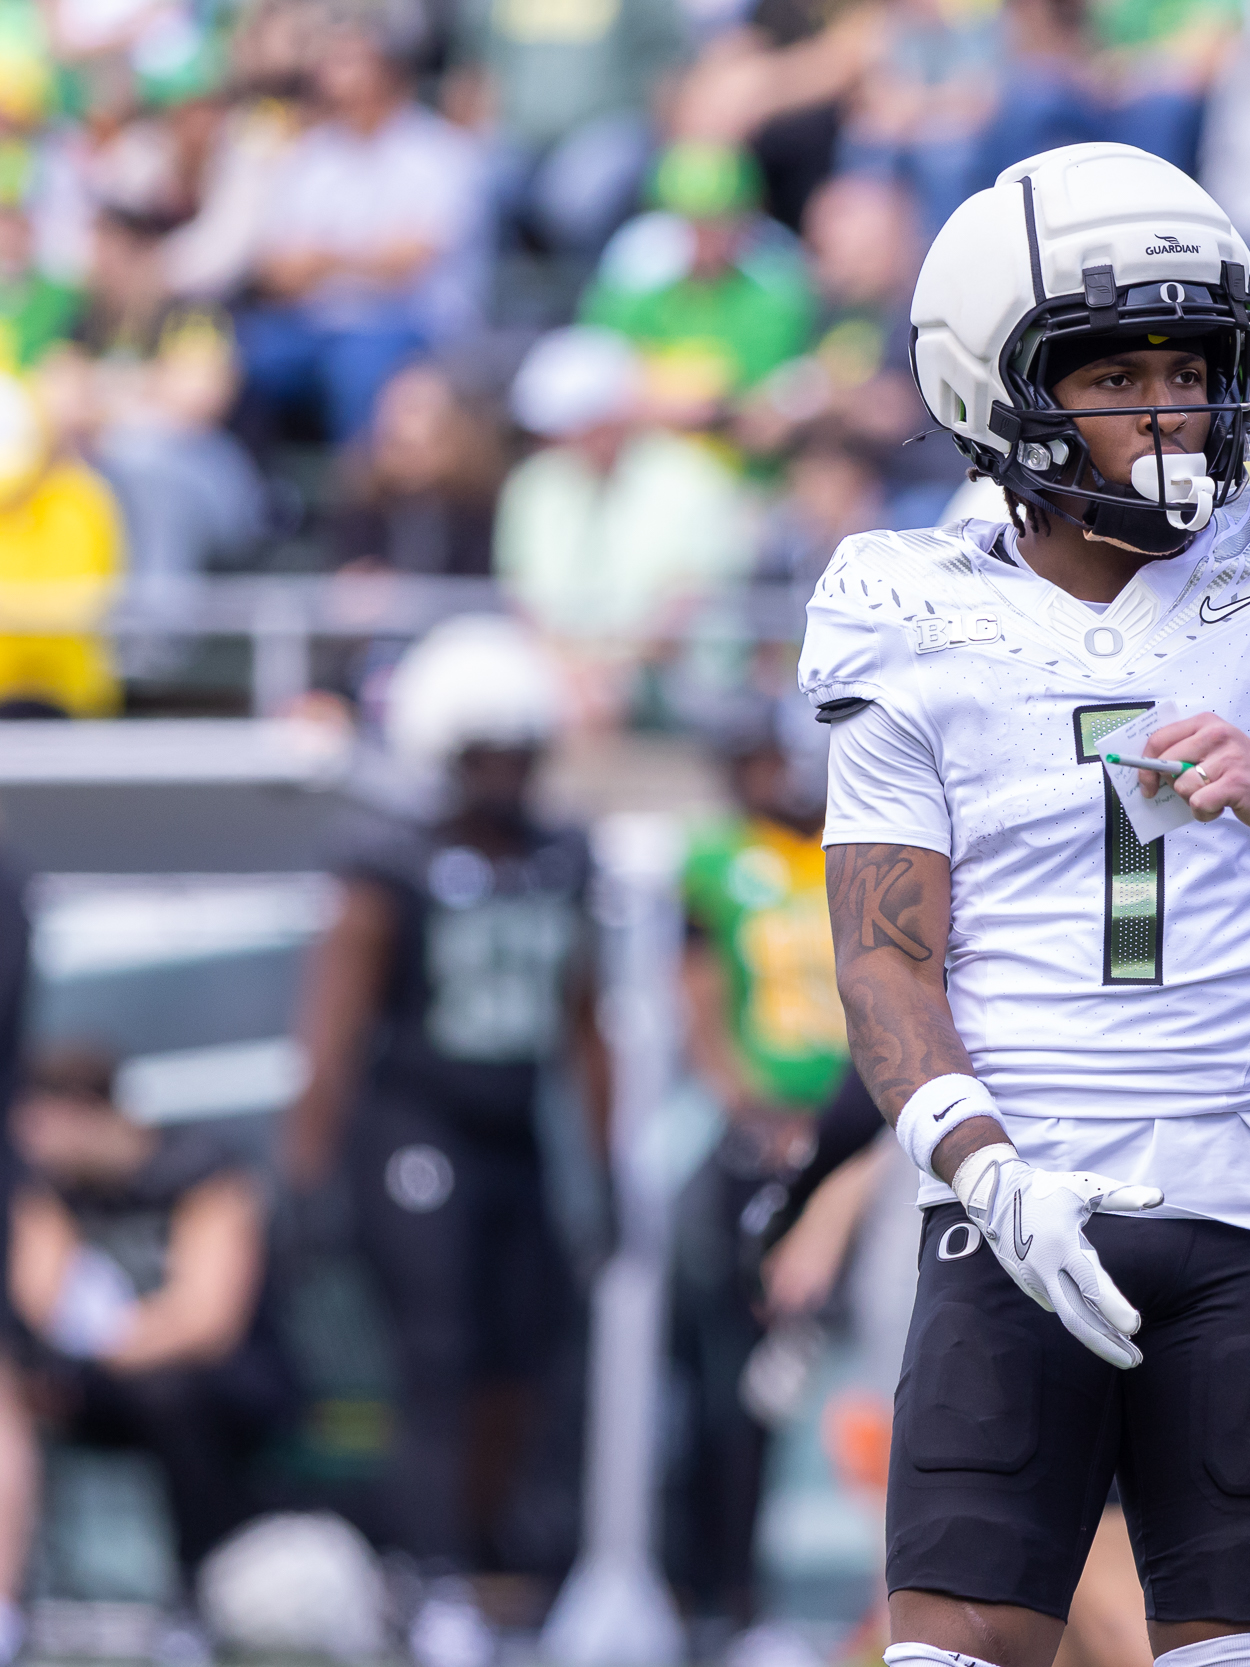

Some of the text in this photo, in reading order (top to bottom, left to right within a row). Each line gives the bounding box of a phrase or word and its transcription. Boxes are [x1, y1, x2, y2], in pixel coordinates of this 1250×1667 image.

[1084, 626, 1124, 657] O
[1072, 700, 1166, 987] 1
[937, 1221, 983, 1261] O
